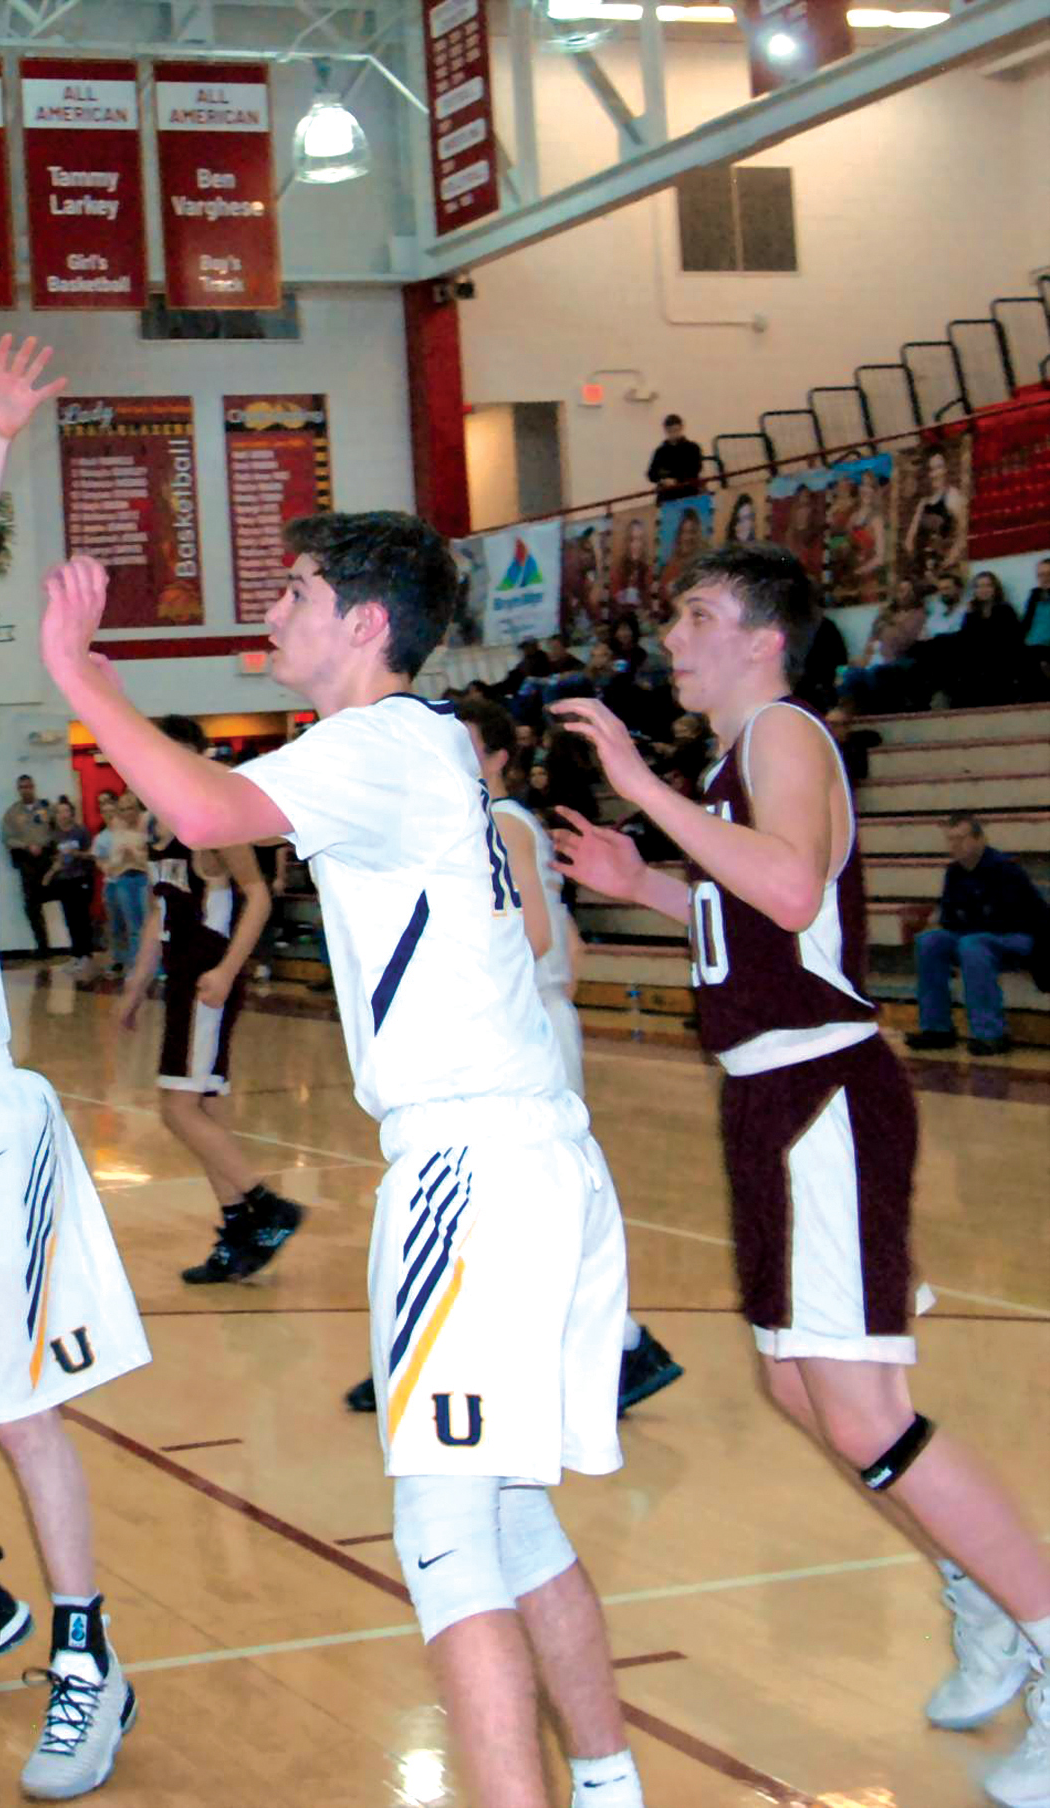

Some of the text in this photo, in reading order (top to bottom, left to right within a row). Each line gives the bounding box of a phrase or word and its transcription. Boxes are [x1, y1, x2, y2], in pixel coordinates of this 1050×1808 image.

[64, 86, 98, 101] ALL
[197, 89, 229, 104] ALL
[36, 106, 128, 122] AMERICAN
[170, 109, 261, 124] AMERICAN
[47, 165, 119, 192] Tammy
[196, 168, 236, 189] Ben
[47, 275, 131, 293] Basketball
[168, 439, 197, 579] Basketball
[687, 880, 730, 986] 0
[49, 1326, 97, 1374] U
[431, 1393, 485, 1447] U
